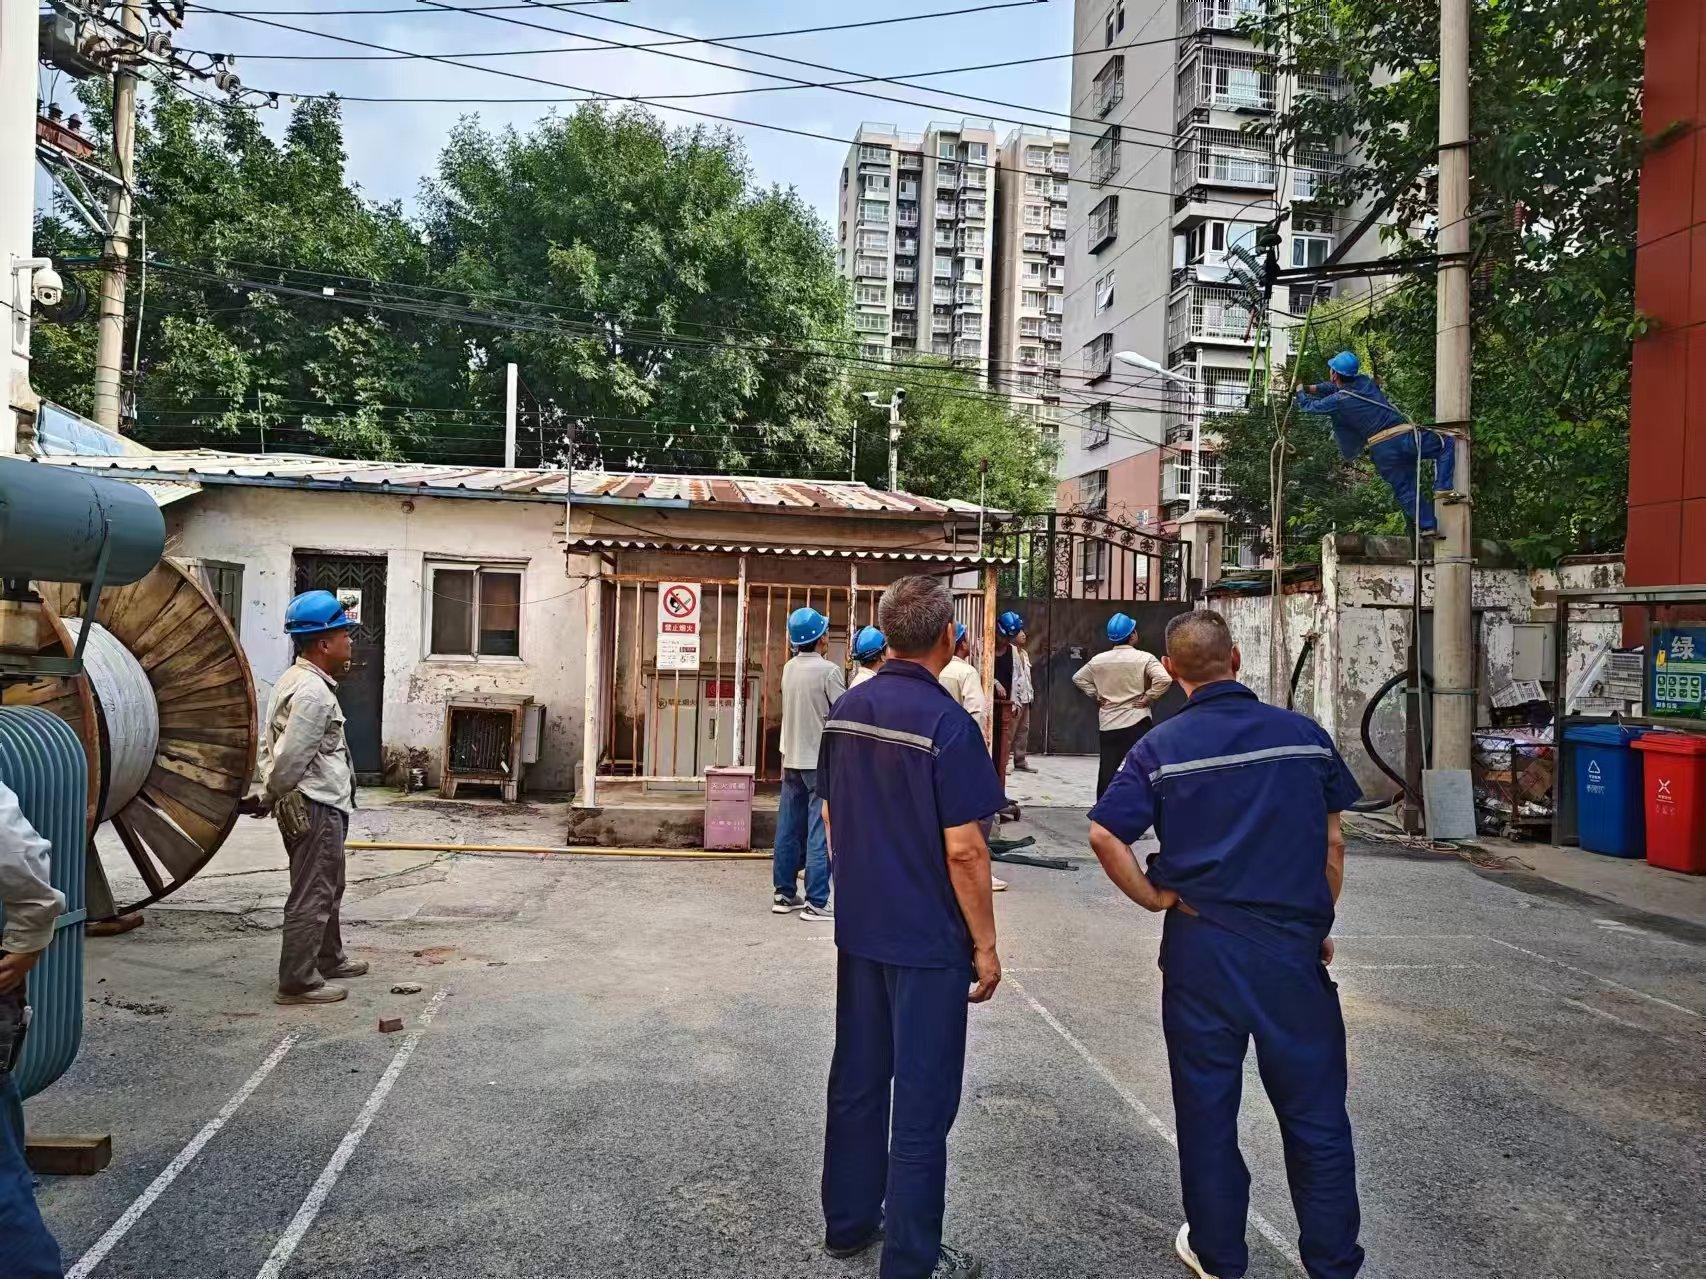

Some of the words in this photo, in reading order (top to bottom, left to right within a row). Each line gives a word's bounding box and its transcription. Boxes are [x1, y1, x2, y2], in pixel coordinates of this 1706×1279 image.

[664, 623, 693, 632] 禁止烟火
[1670, 636, 1695, 660] 绿
